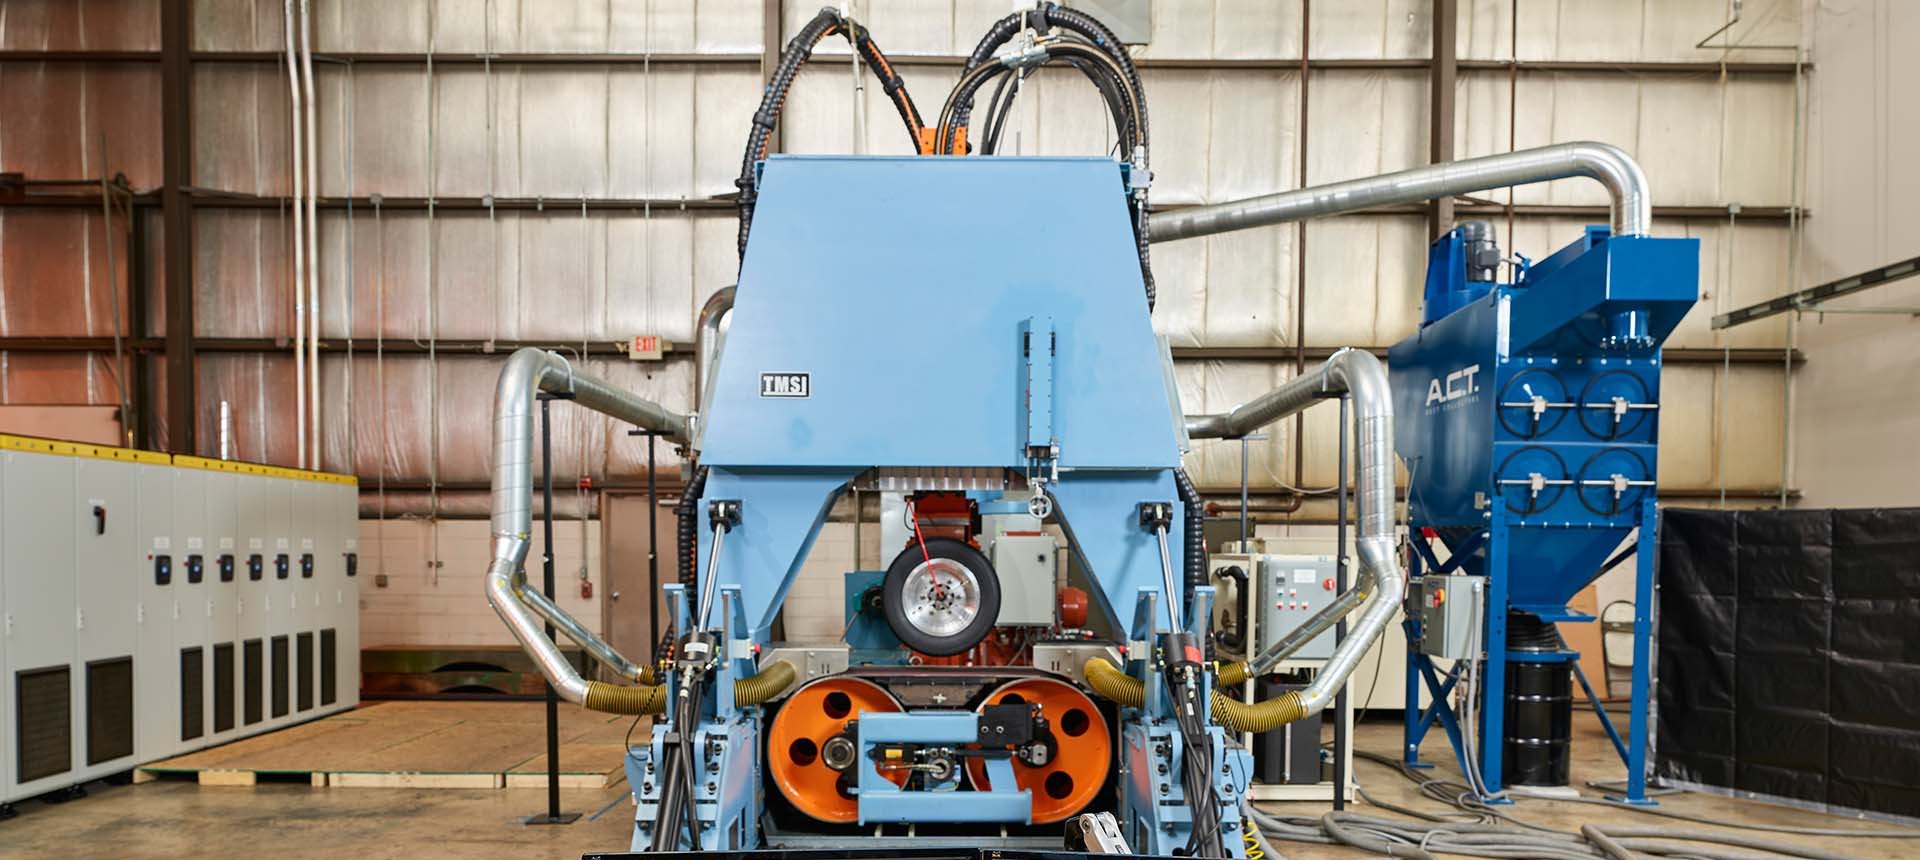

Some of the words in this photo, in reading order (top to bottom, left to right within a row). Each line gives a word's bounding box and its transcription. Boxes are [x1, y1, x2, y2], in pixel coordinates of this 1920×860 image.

[635, 335, 657, 352] EXIT
[763, 375, 808, 393] TMSI
[1425, 363, 1480, 407] A.C.T.
